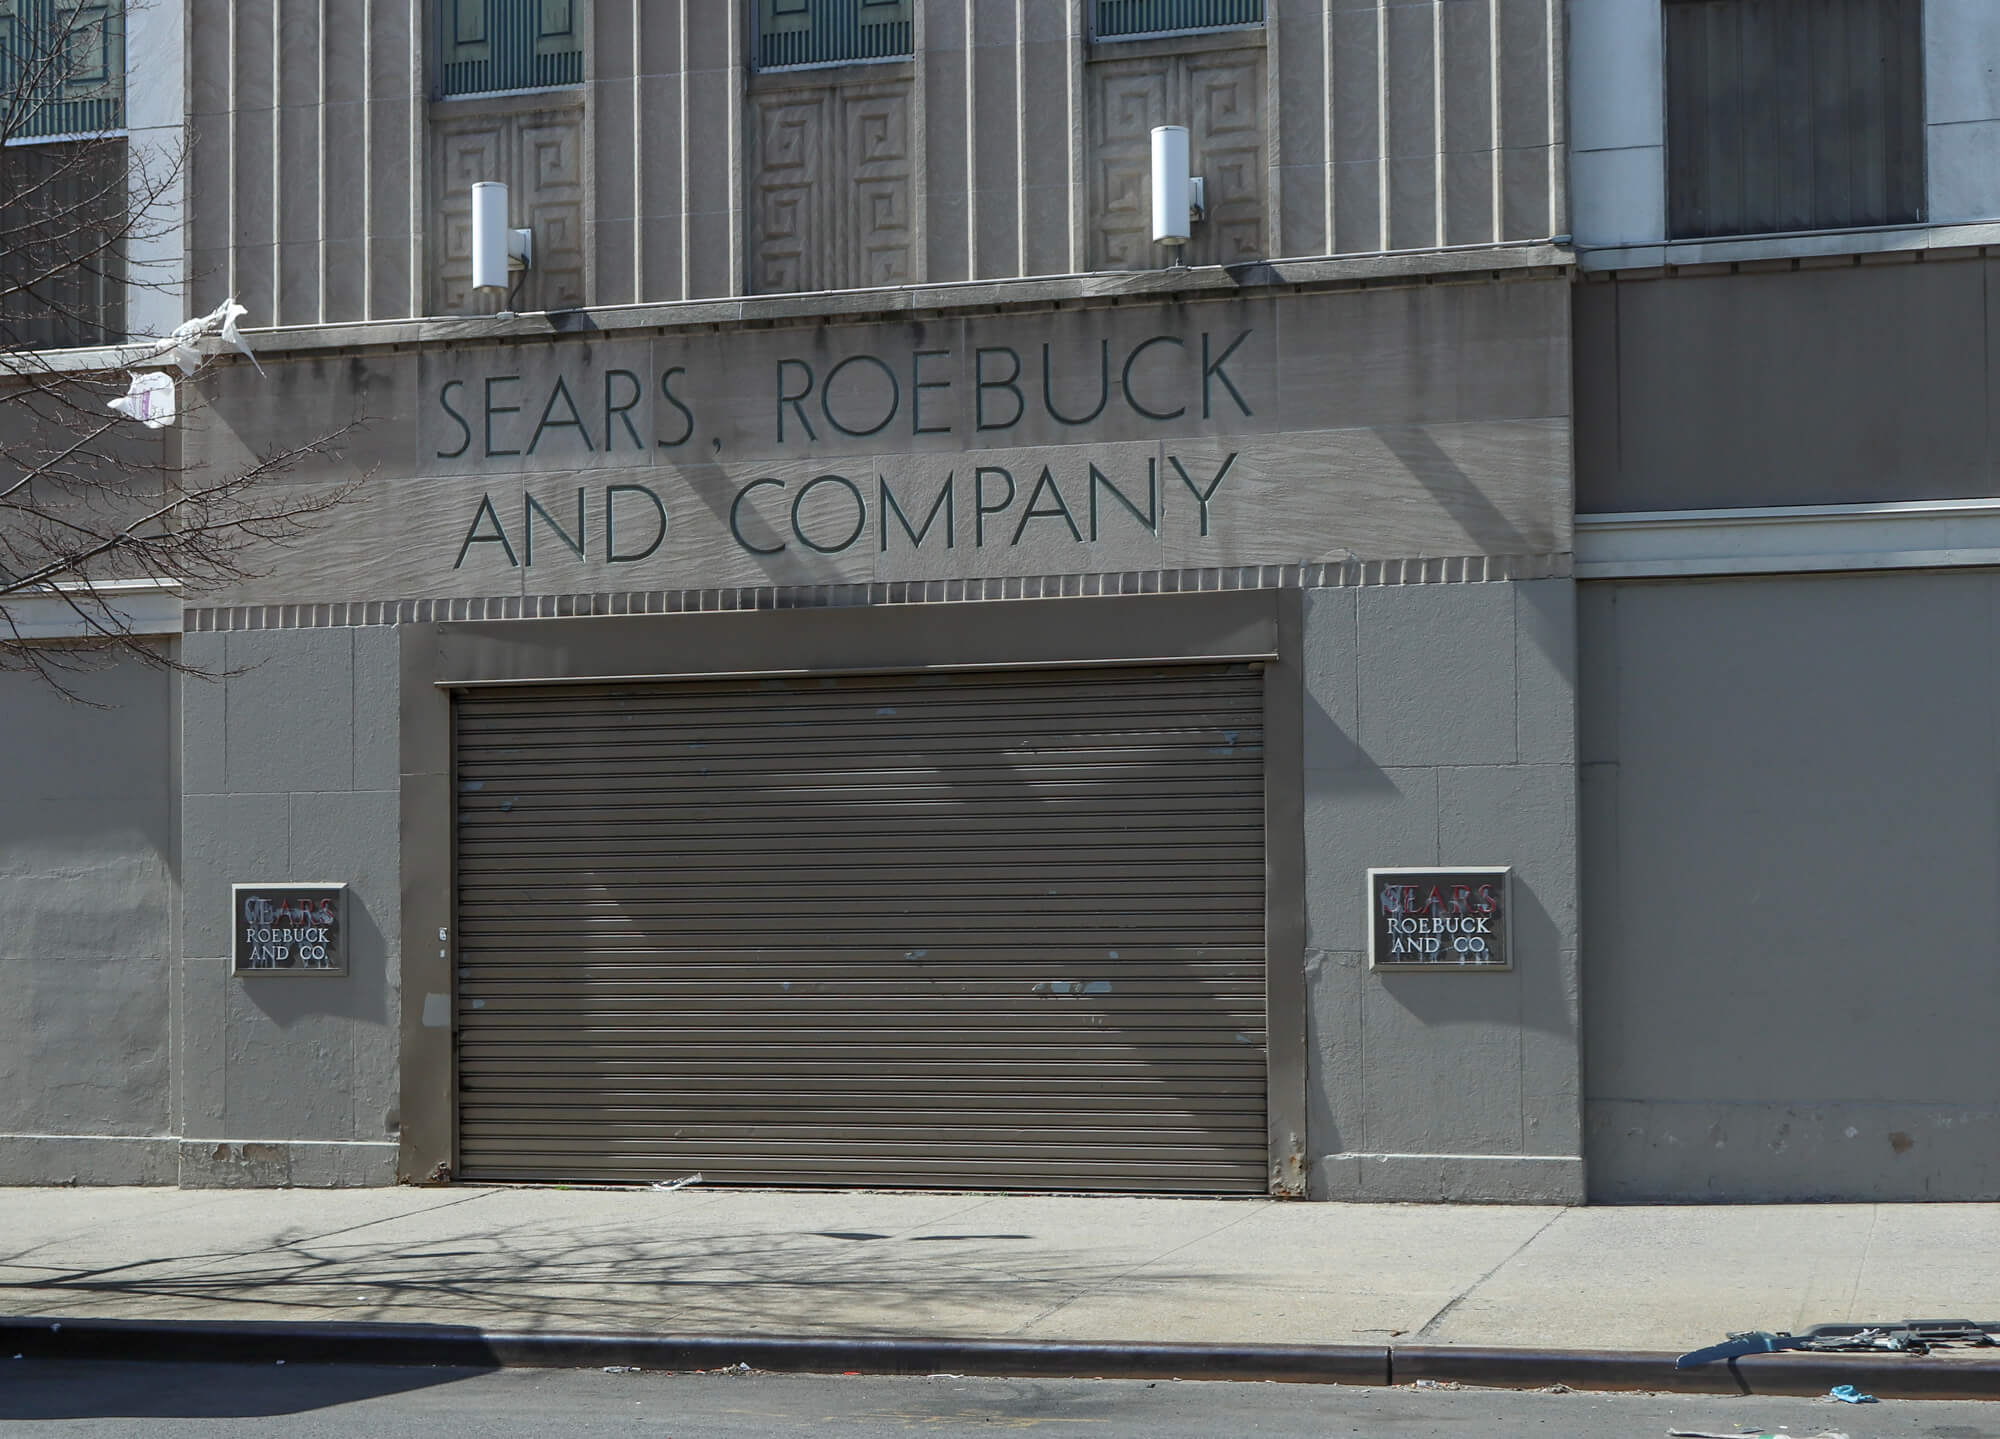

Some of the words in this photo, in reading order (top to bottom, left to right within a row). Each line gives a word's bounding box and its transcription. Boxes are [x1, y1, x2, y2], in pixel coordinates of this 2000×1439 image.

[436, 366, 722, 460] SEARS,
[776, 328, 1254, 443] ROEBUCK
[453, 483, 669, 570] AND
[729, 452, 1239, 555] COMPANY
[1387, 916, 1493, 934] ROEBUCK
[246, 927, 331, 943] ROEBUCK
[249, 945, 290, 961] AND
[299, 945, 329, 961] CO.
[1391, 936, 1440, 954] AND
